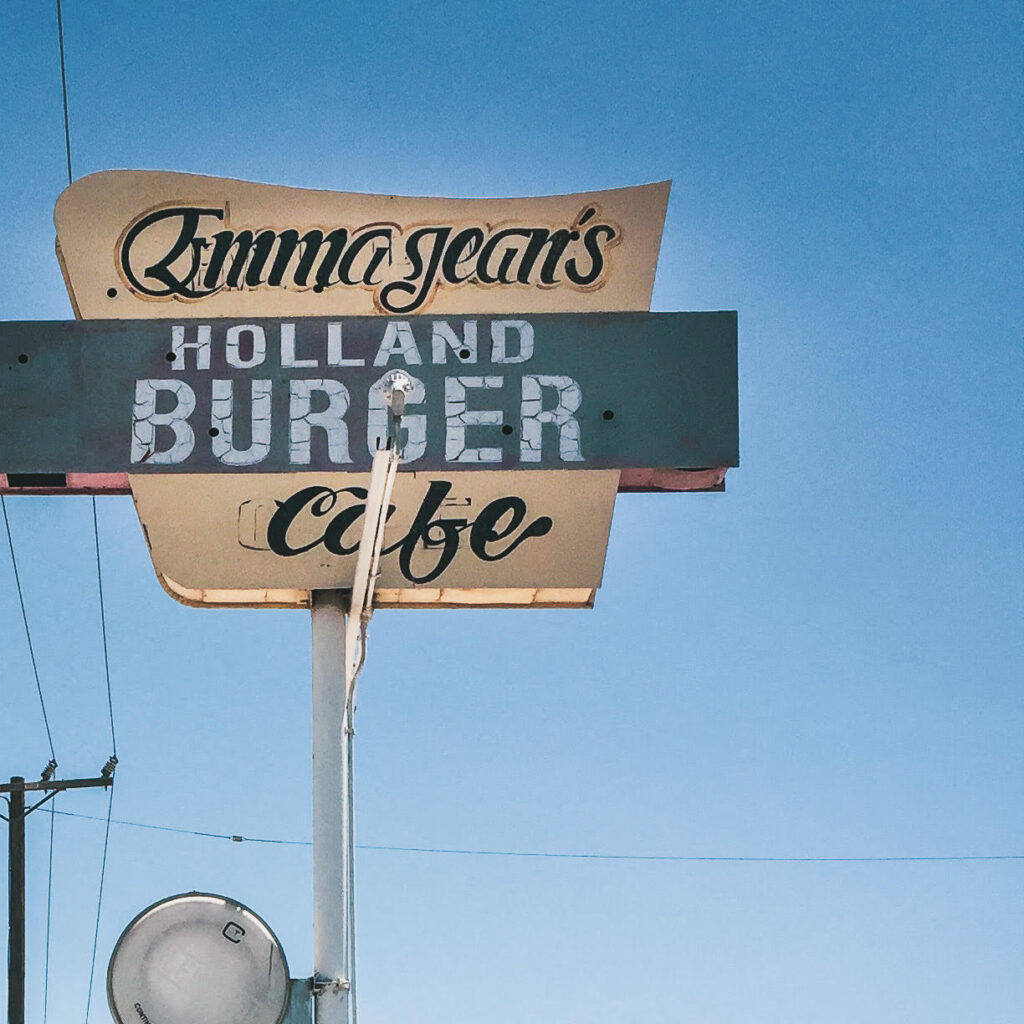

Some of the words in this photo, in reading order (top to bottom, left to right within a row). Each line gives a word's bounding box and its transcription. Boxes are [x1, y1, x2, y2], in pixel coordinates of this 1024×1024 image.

[122, 207, 391, 300] Emma
[379, 207, 617, 314] Jean's
[171, 320, 534, 370] HOLLAND
[130, 375, 585, 465] BURGER
